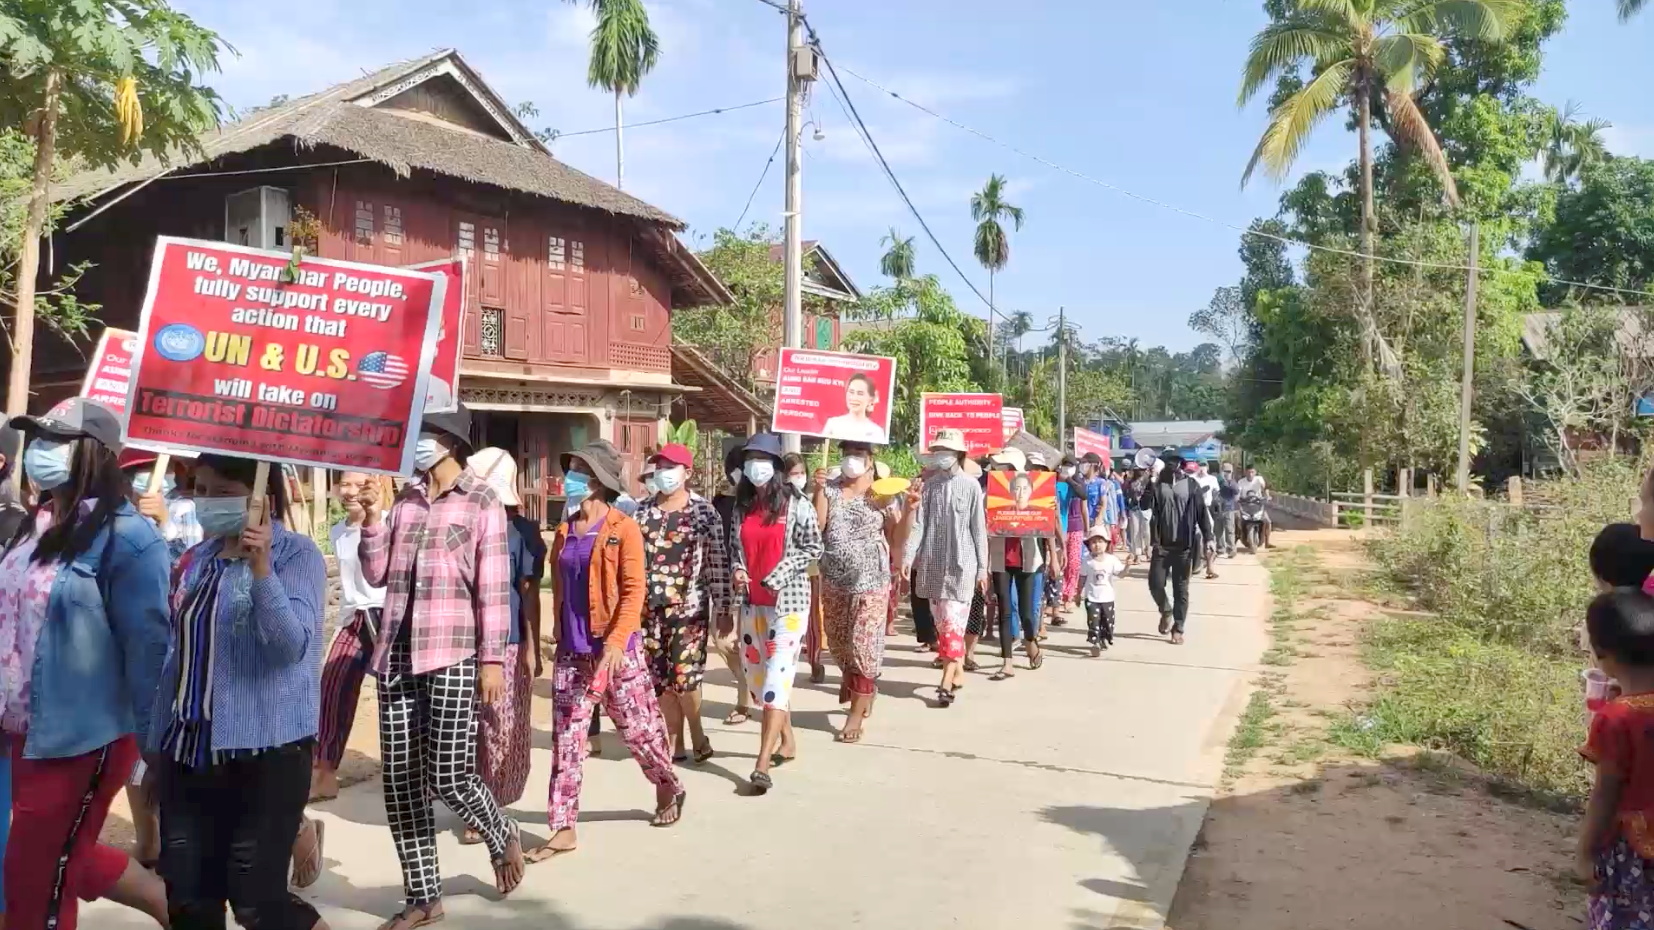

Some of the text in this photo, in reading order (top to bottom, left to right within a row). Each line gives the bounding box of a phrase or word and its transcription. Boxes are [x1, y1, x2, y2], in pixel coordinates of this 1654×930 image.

[194, 275, 393, 322] fully support every
[231, 307, 347, 337] action that
[204, 330, 357, 381] UN & U.S.
[214, 378, 337, 410] will take on
[780, 398, 820, 407] ARRESTED
[142, 391, 400, 447] Terrorist Dictatorship
